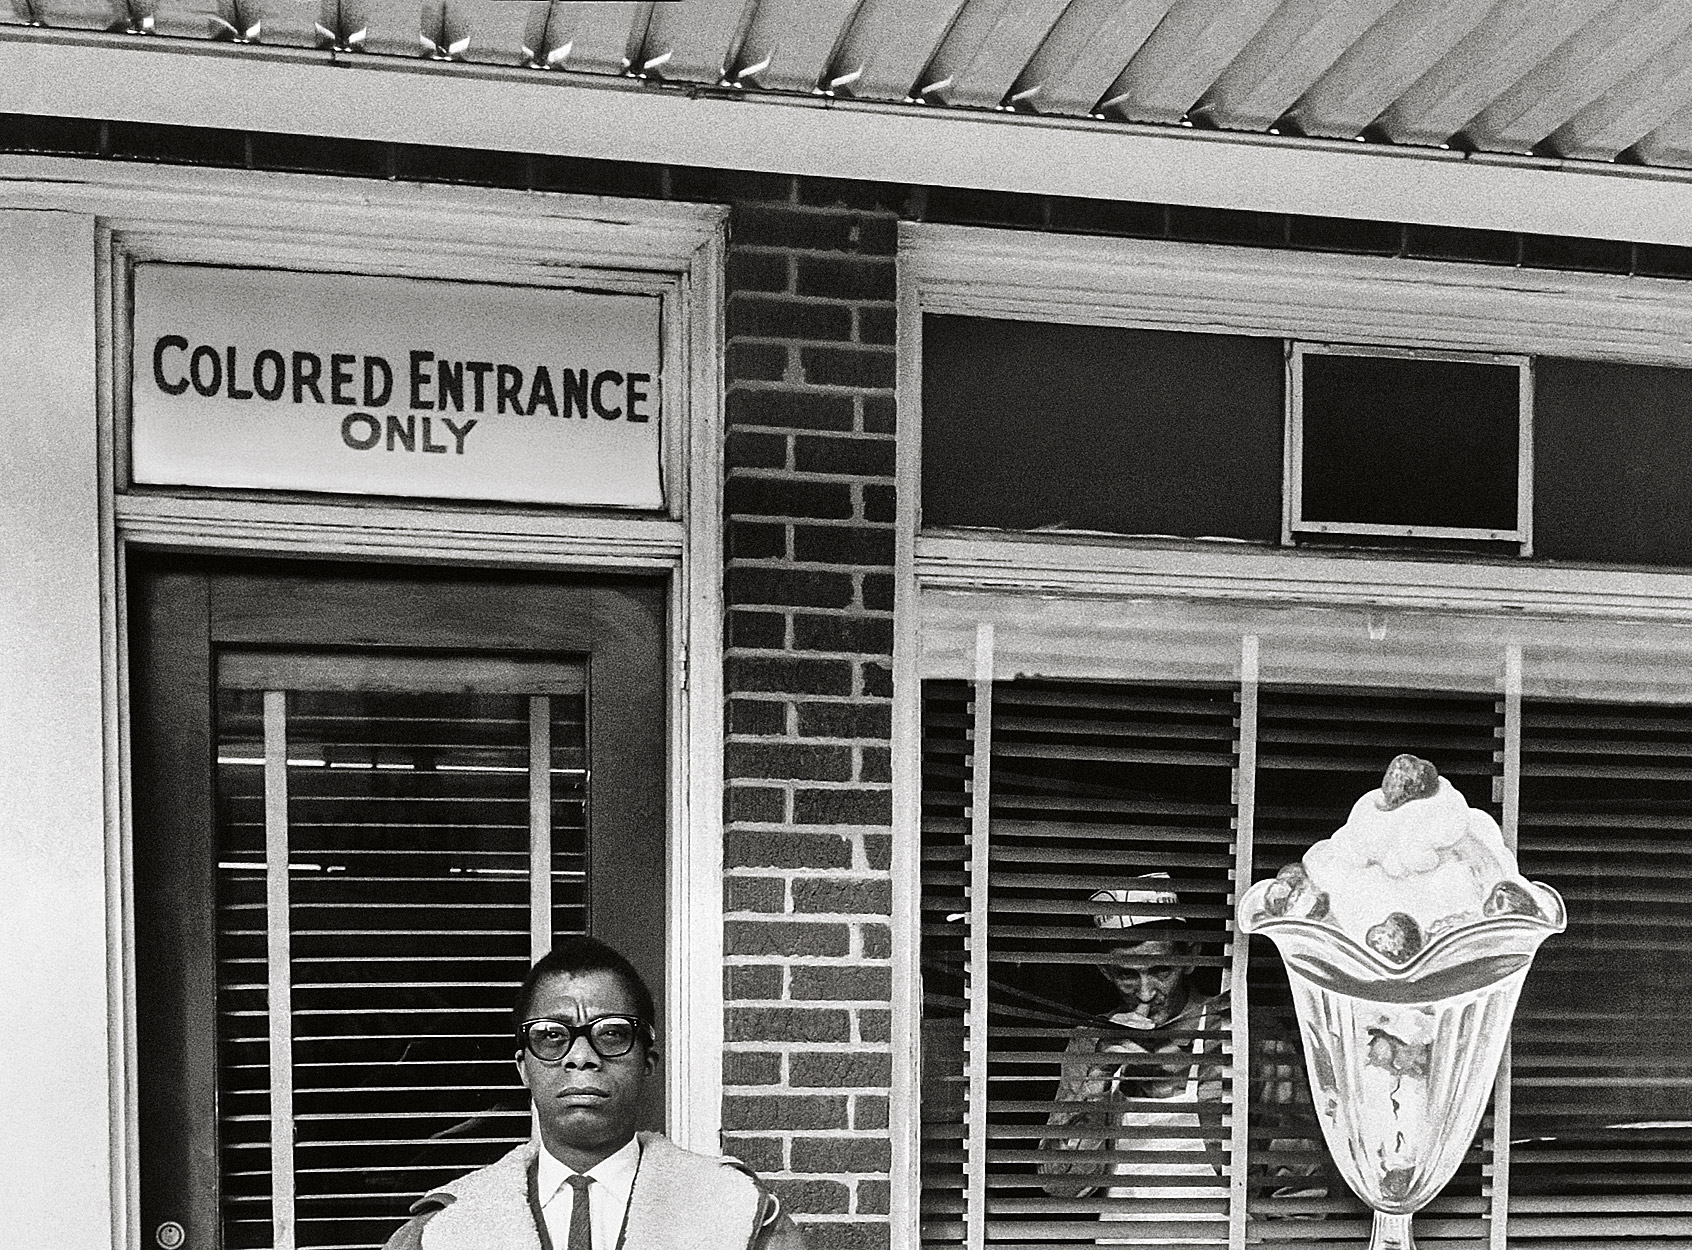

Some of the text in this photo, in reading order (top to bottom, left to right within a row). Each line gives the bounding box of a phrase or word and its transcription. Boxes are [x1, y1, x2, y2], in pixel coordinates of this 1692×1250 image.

[153, 334, 652, 423] COLORED ENTRANCE
[340, 412, 478, 455] ONLY
